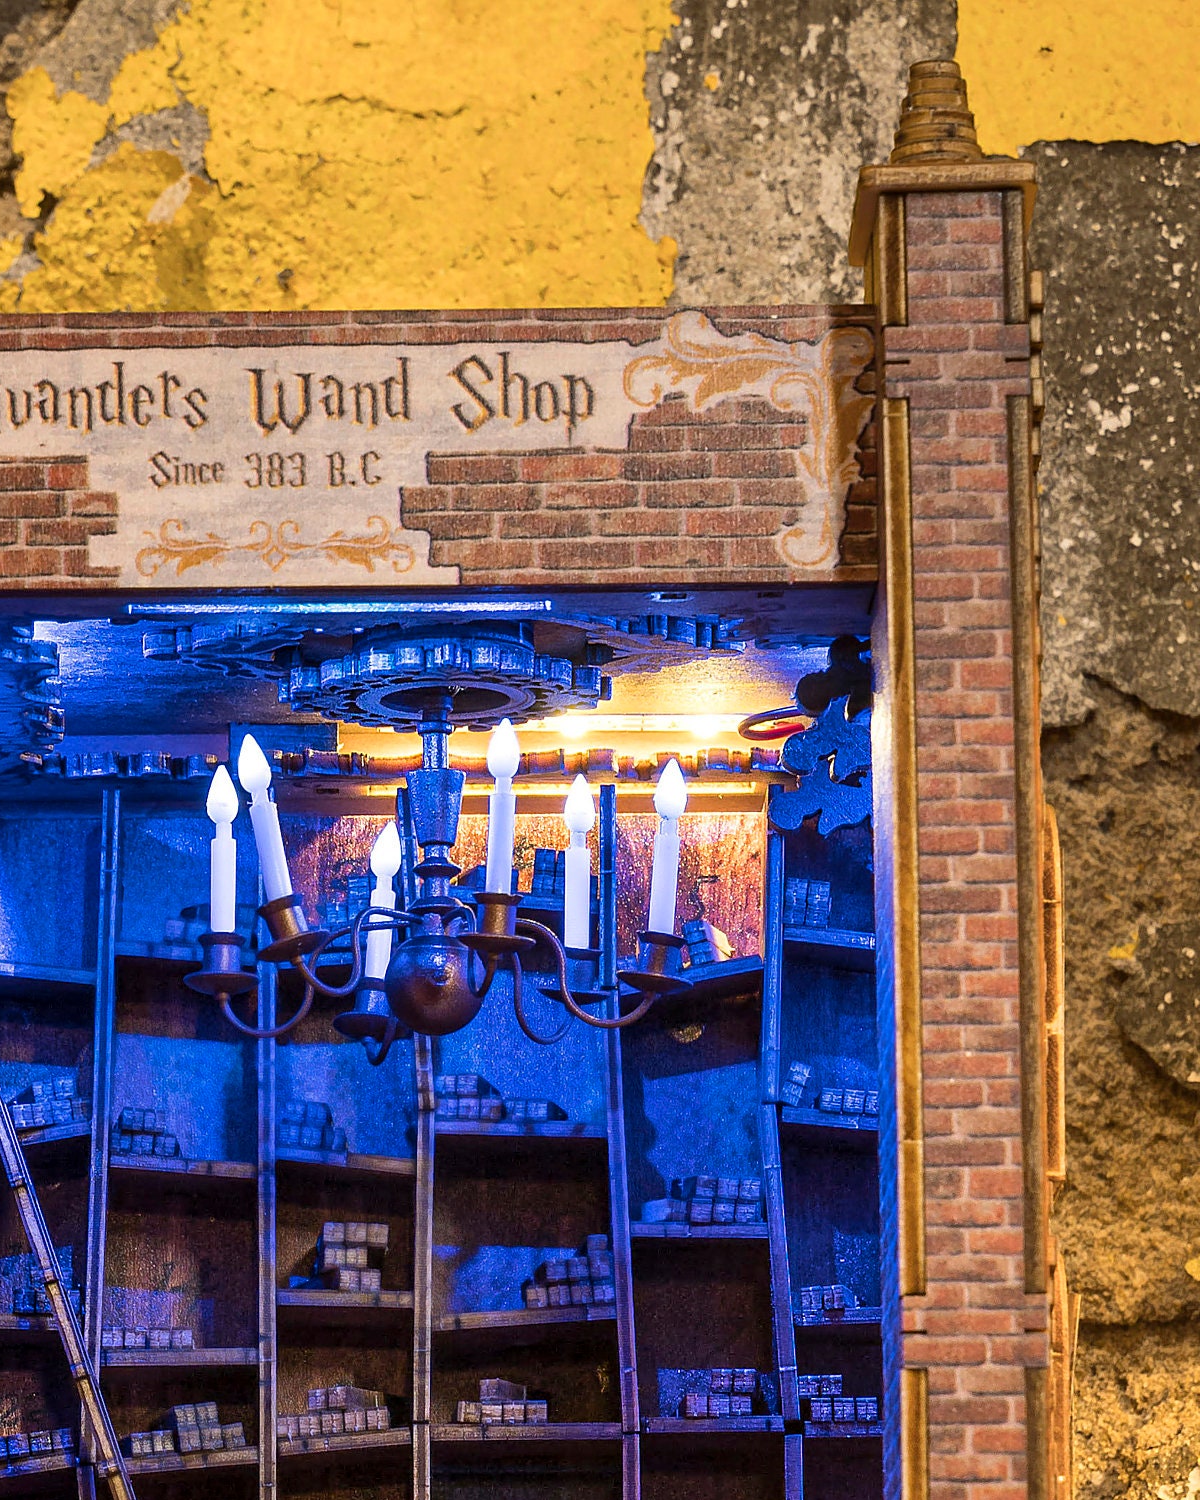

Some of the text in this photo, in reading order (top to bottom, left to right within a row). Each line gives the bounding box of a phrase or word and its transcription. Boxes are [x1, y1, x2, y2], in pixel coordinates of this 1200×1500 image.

[244, 356, 410, 437] Wand
[447, 351, 594, 447] Shop
[148, 450, 382, 492] Since 383 B.C
